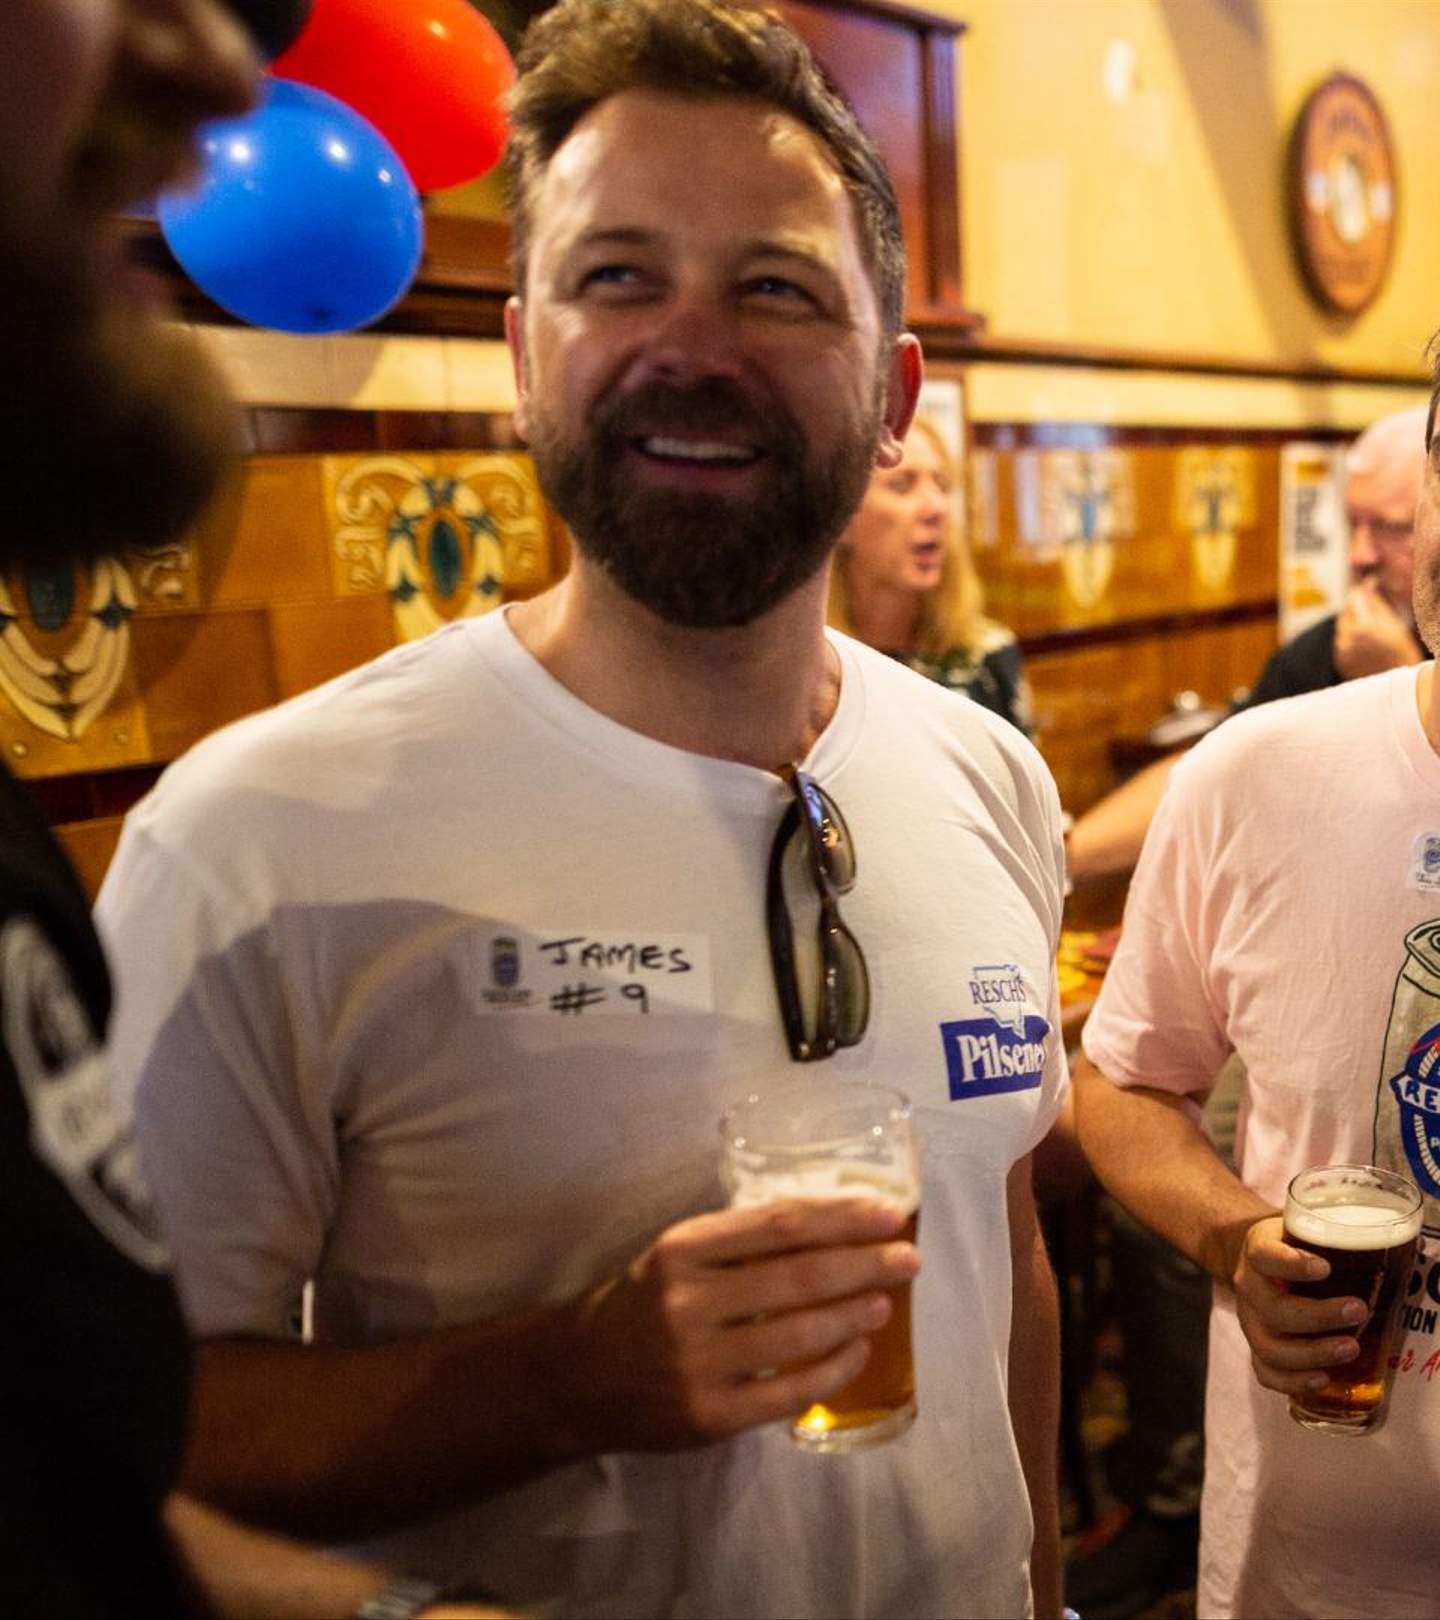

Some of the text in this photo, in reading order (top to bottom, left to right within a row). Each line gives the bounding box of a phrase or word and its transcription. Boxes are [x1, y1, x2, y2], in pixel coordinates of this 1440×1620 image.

[538, 937, 692, 974] JAMES
[968, 977, 1026, 1005] RESCHS
[956, 1032, 1046, 1083] Pilsene
